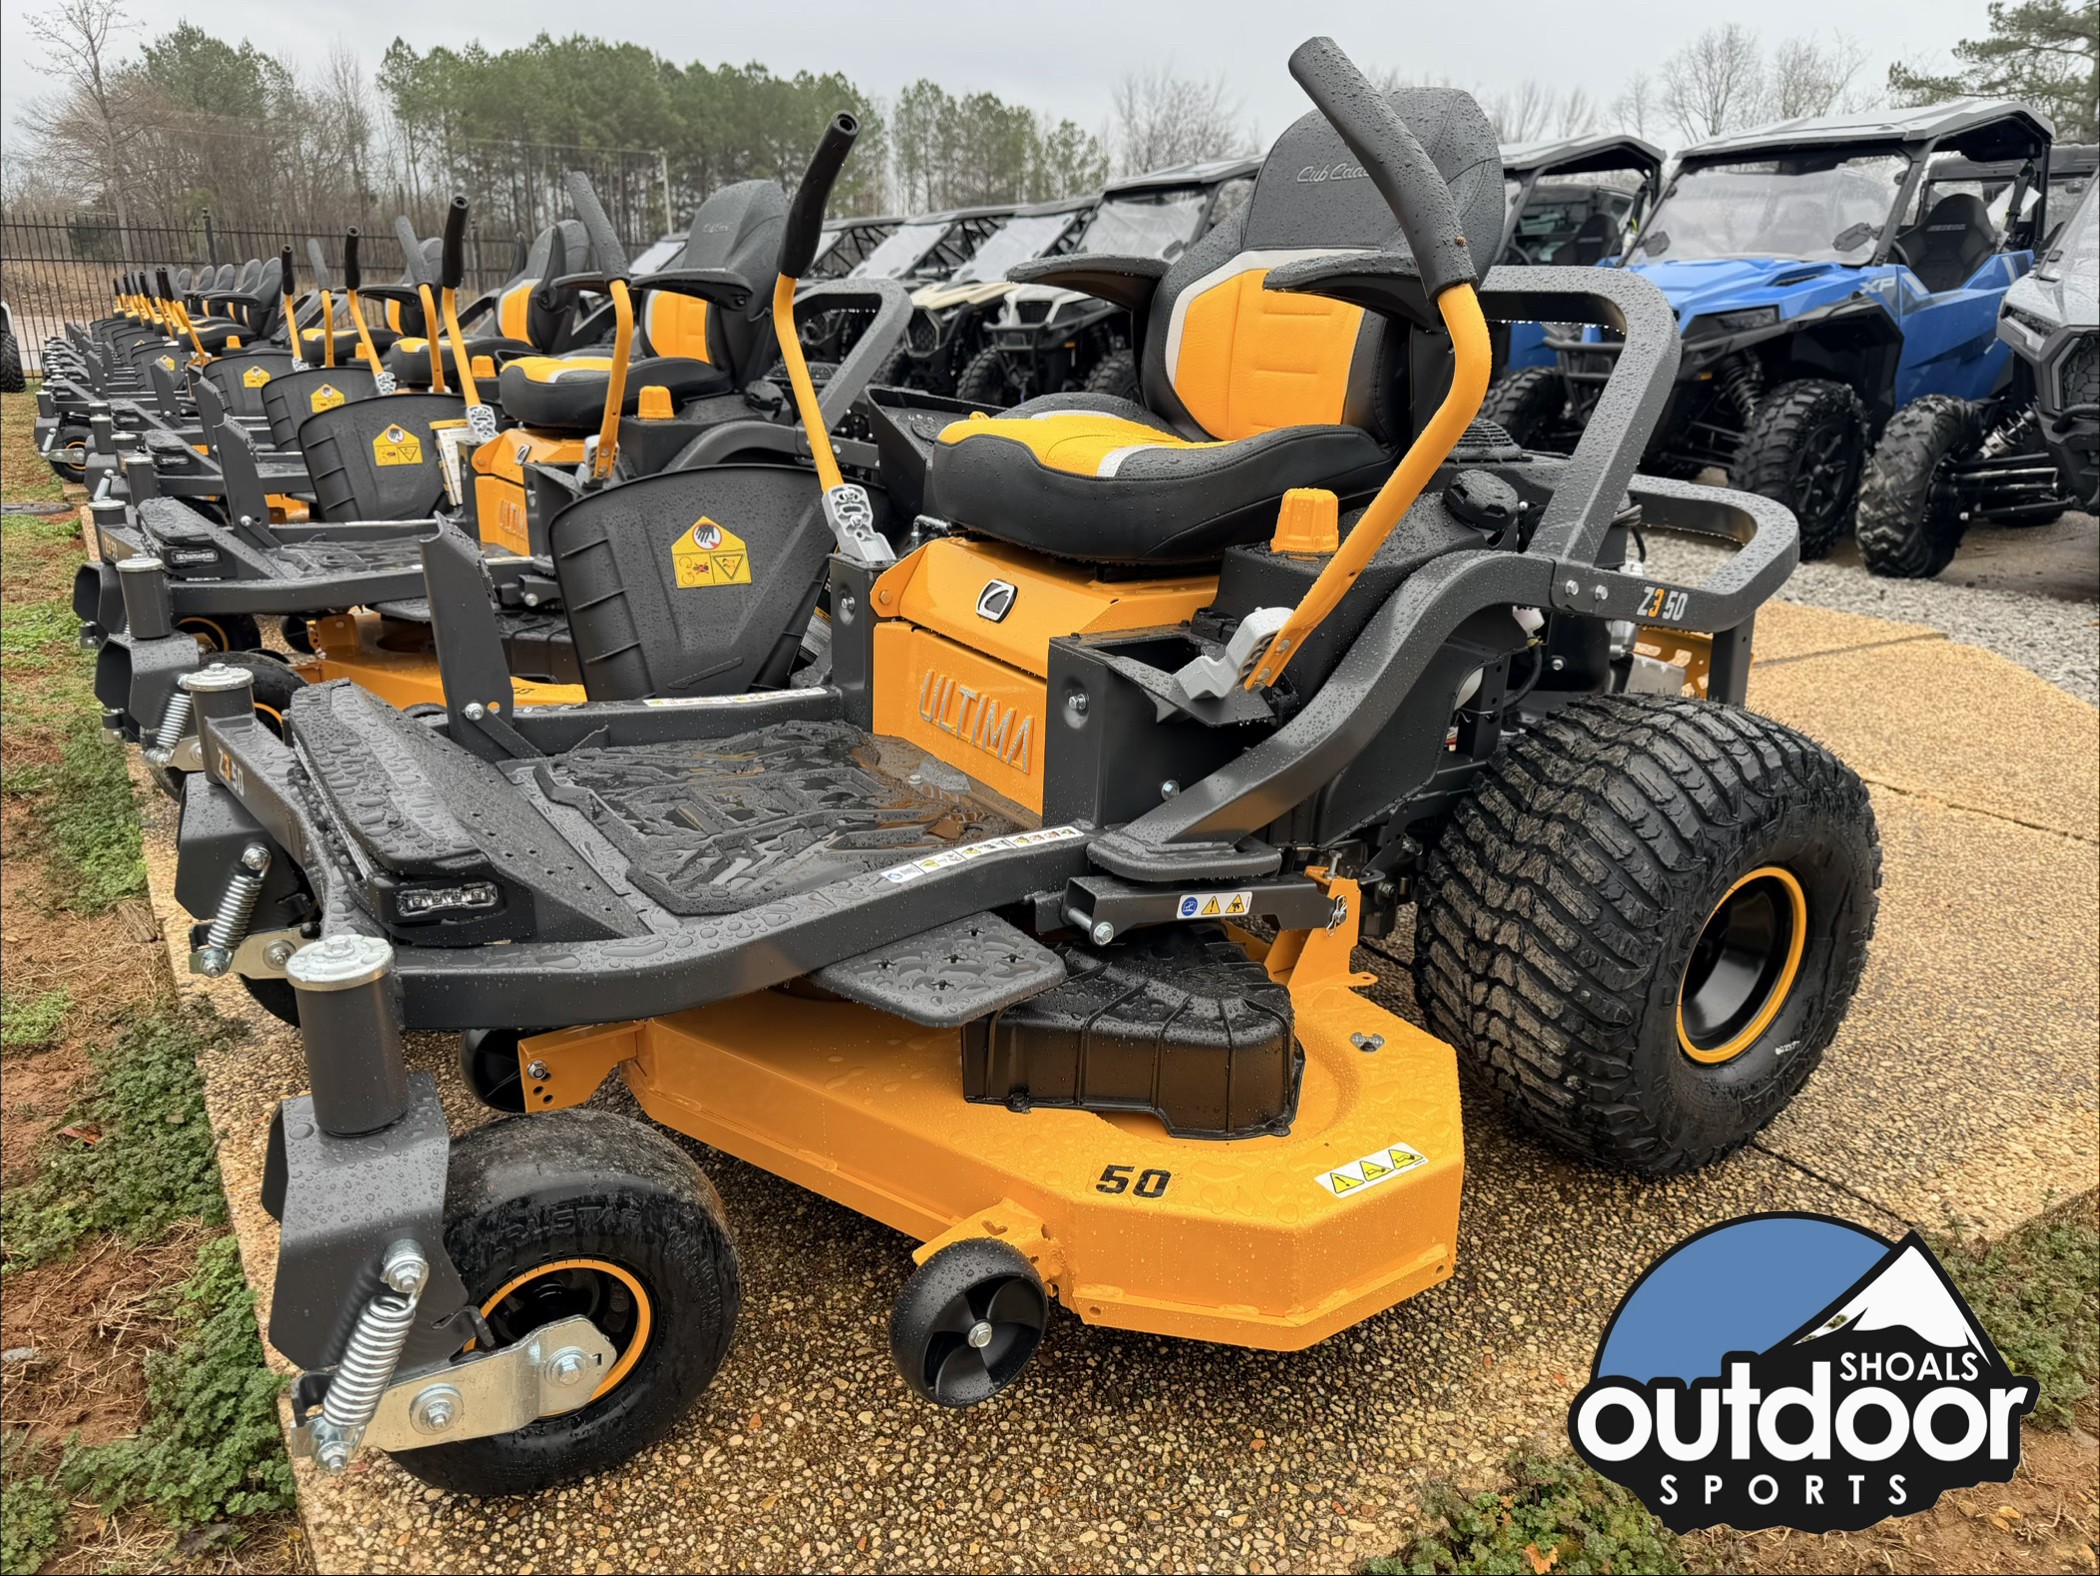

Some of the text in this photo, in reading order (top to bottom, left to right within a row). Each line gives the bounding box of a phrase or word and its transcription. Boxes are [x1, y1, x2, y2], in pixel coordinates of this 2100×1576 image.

[1297, 162, 1370, 182] Cub Cad
[920, 668, 1034, 776] ULTIMA
[1095, 1164, 1172, 1199] 50
